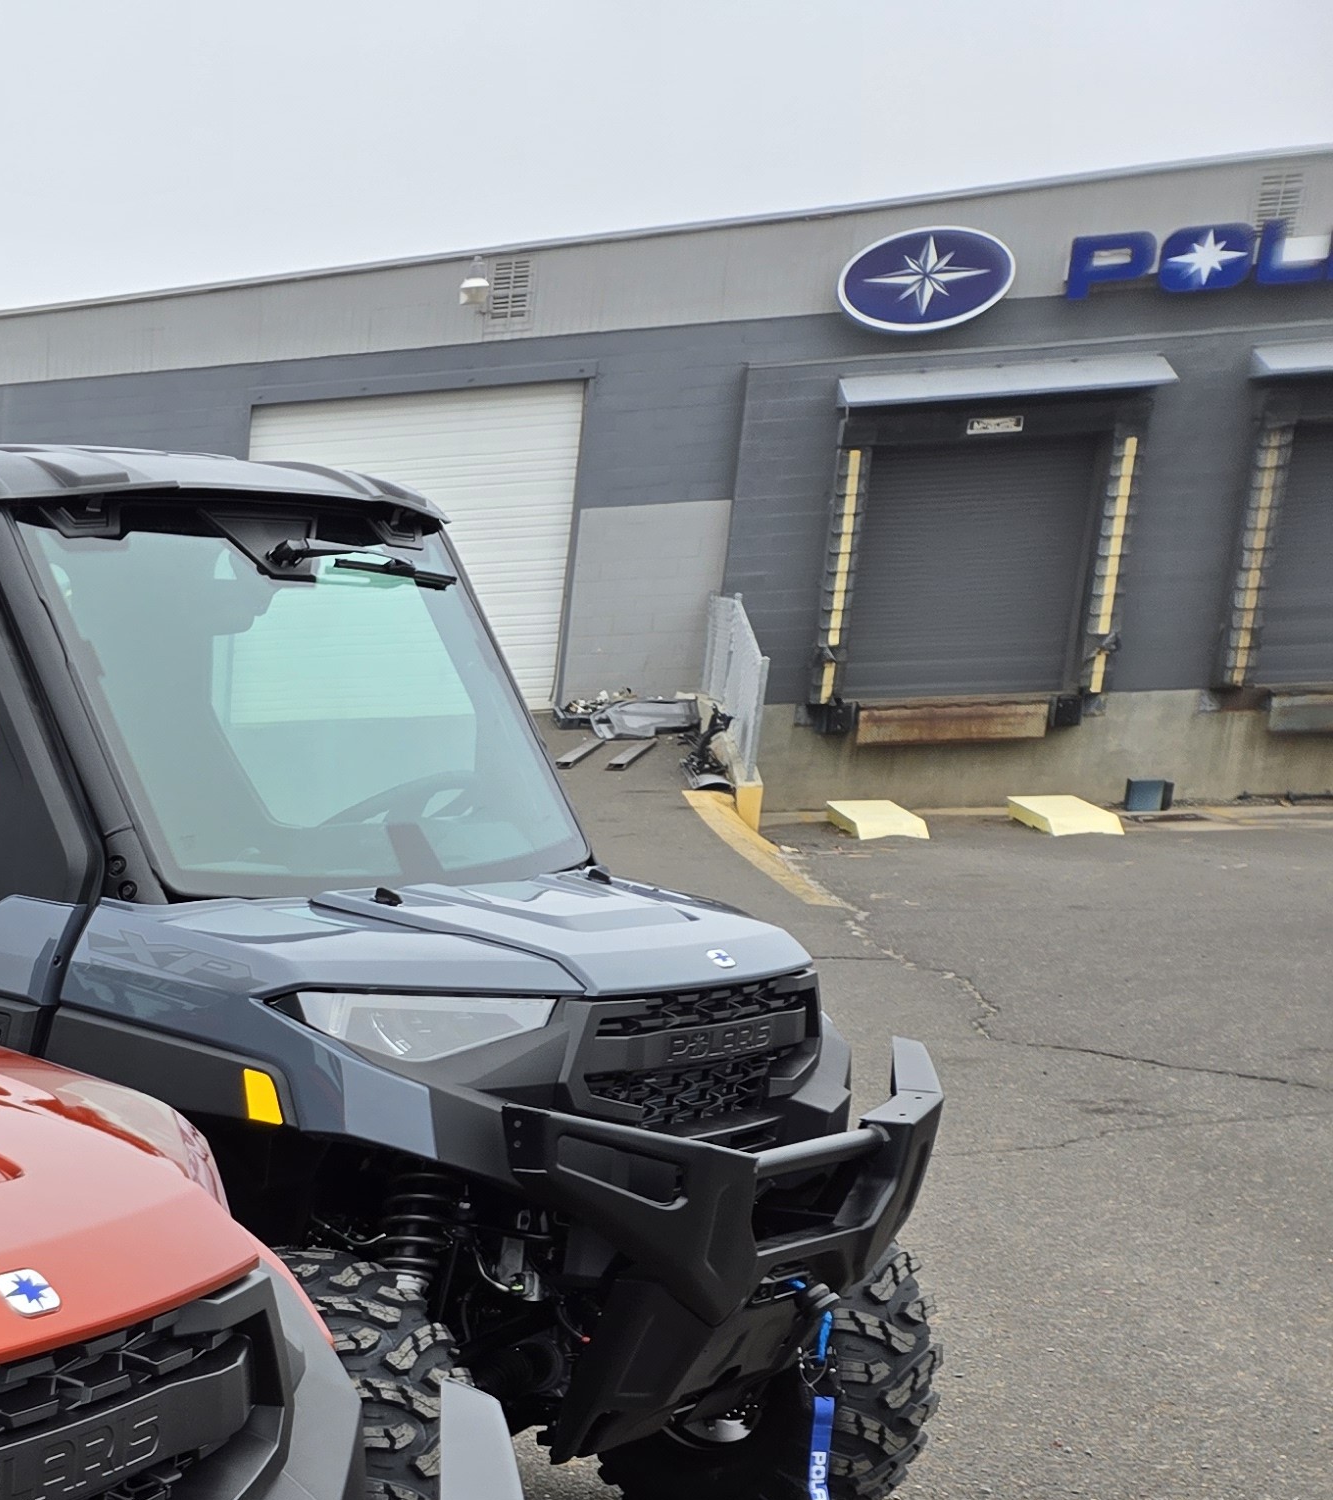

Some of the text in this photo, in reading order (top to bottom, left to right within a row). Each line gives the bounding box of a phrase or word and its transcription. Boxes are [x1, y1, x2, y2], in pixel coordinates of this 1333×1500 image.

[1066, 219, 1333, 301] POL
[90, 929, 252, 979] XP
[667, 1022, 771, 1063] POLARIS
